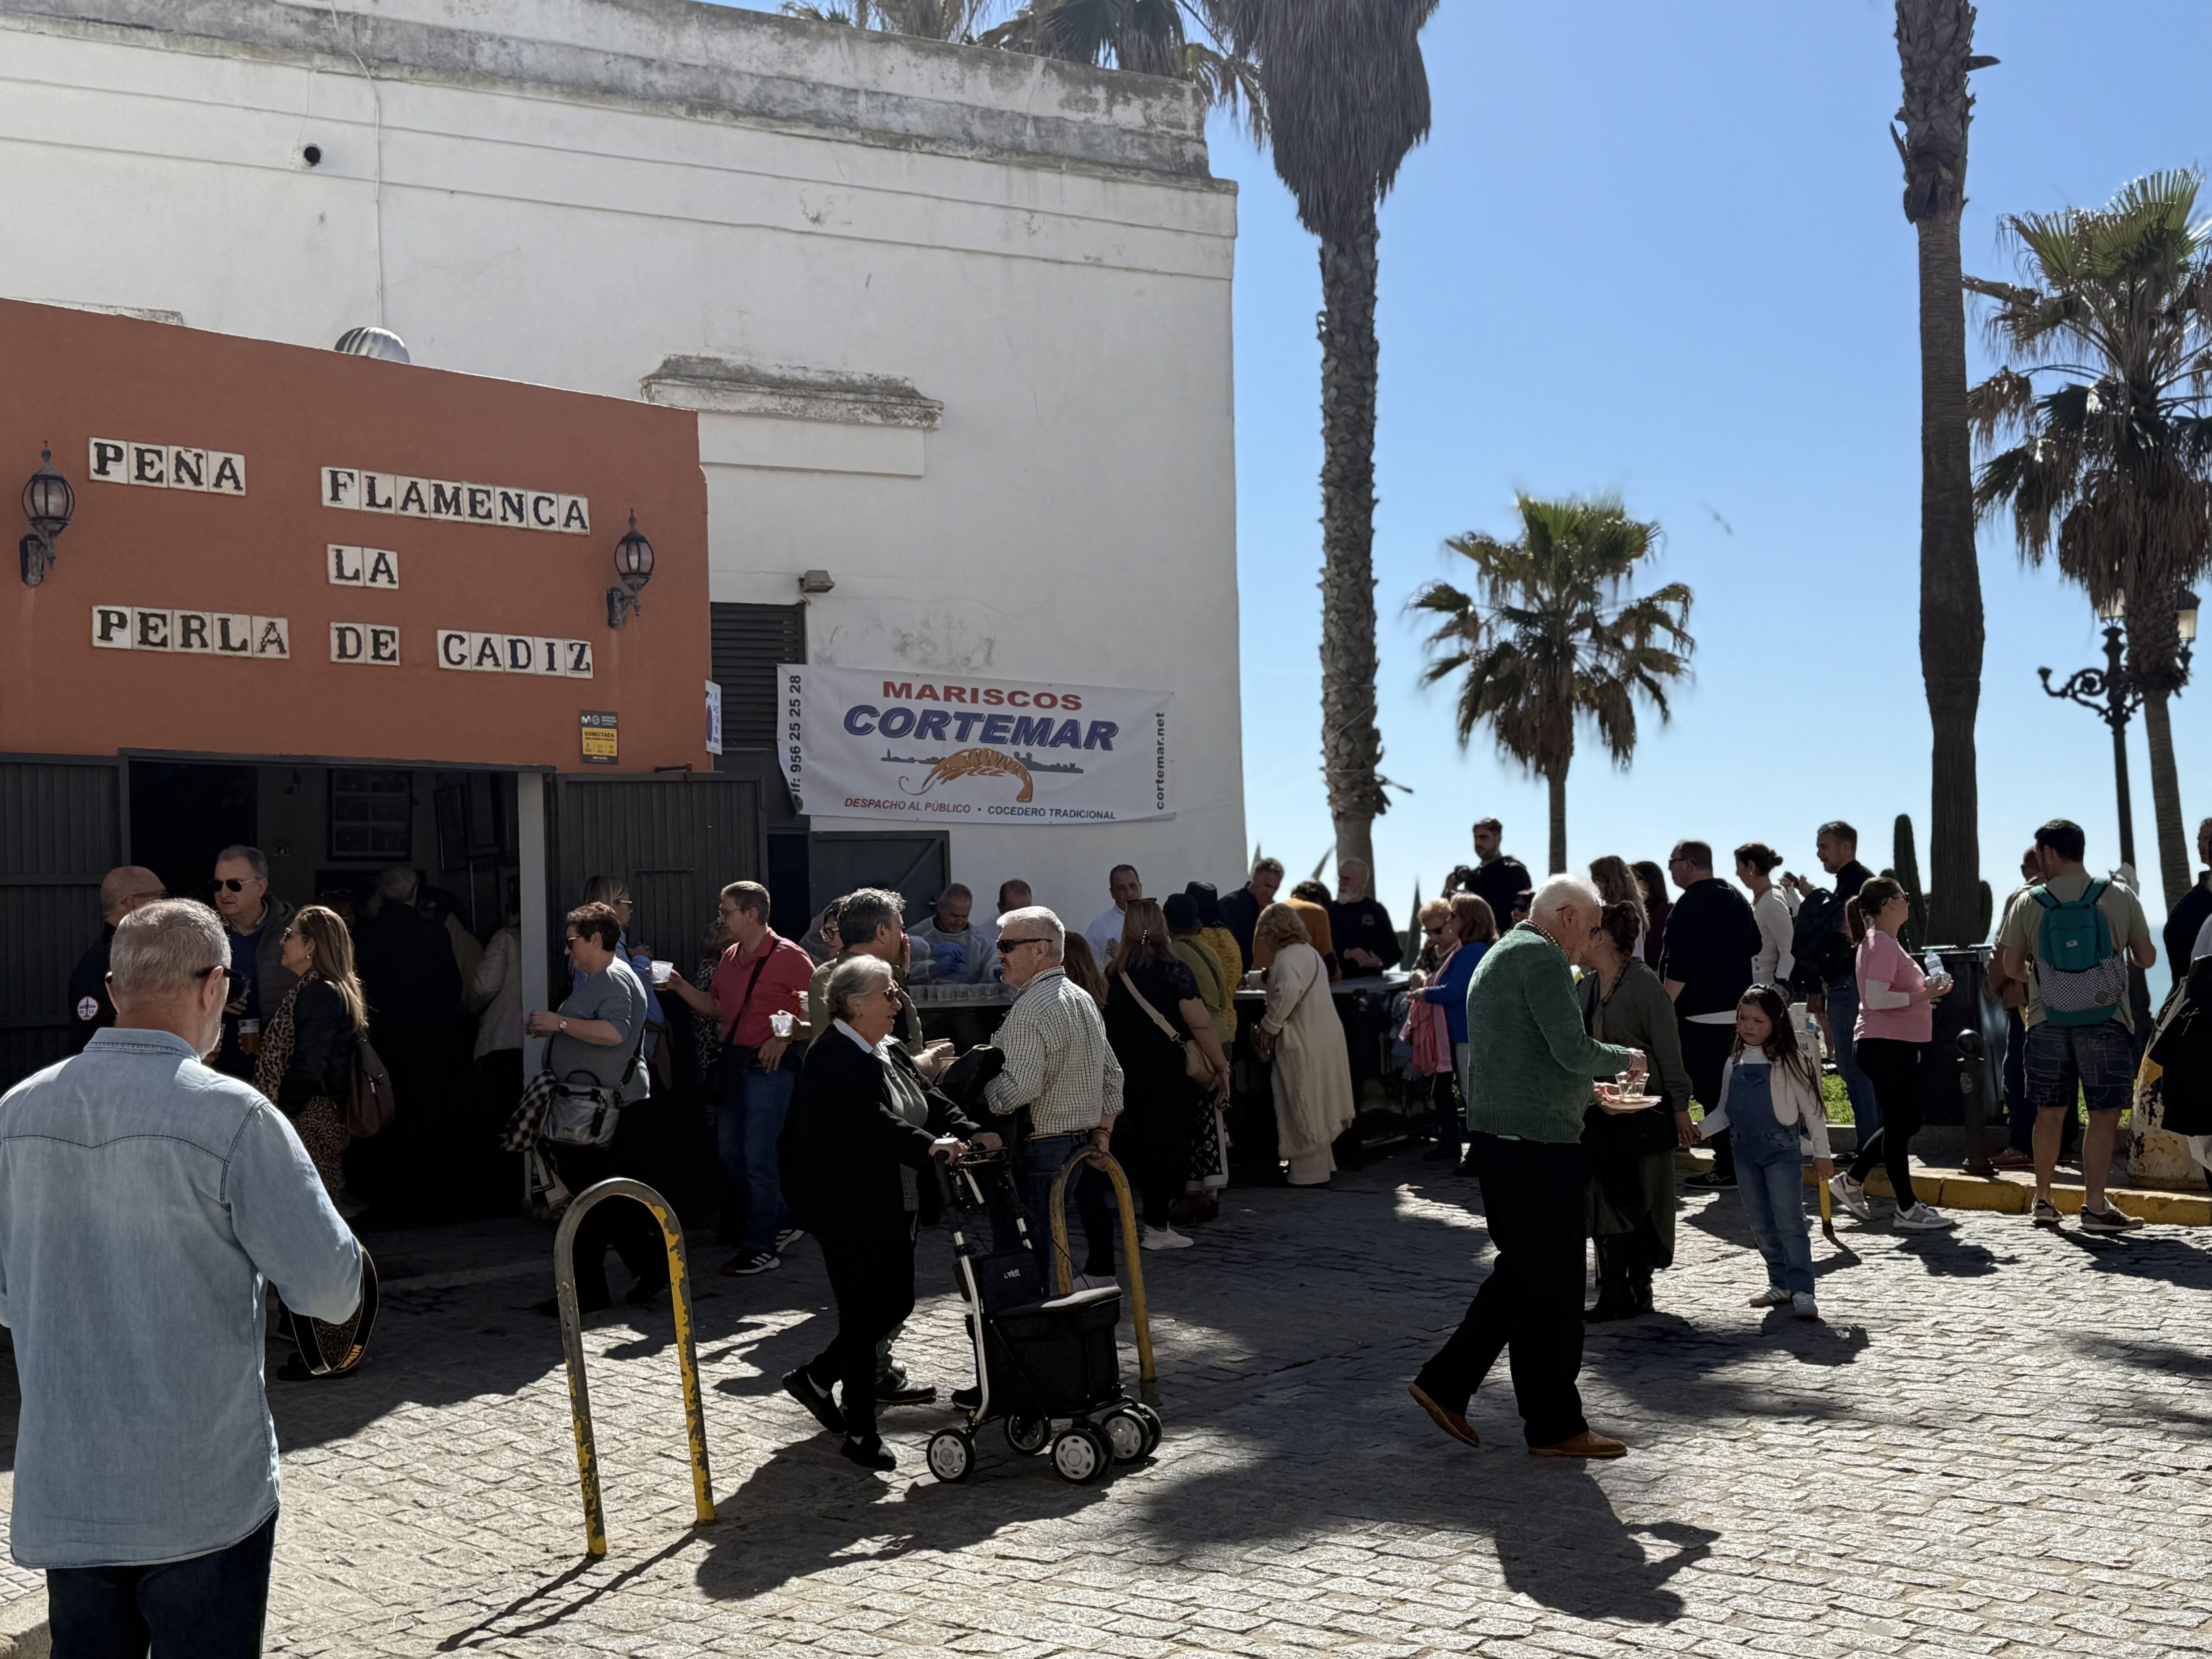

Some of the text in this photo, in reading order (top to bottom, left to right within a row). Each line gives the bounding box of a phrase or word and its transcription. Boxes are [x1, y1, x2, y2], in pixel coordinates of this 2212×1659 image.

[328, 469, 588, 529] FLAMENCA
[334, 549, 397, 585] LA
[97, 609, 285, 654] PERLA
[335, 626, 397, 661] DE
[883, 681, 1082, 711] MARISCOS
[789, 675, 801, 792] lf: 956 25 25 28
[844, 704, 1118, 751] CORTEMAR
[1155, 712, 1165, 810] cortemar.net
[845, 798, 1116, 819] DESPACHO AL PÚBLICO COCEDERO TRADICIONAL
